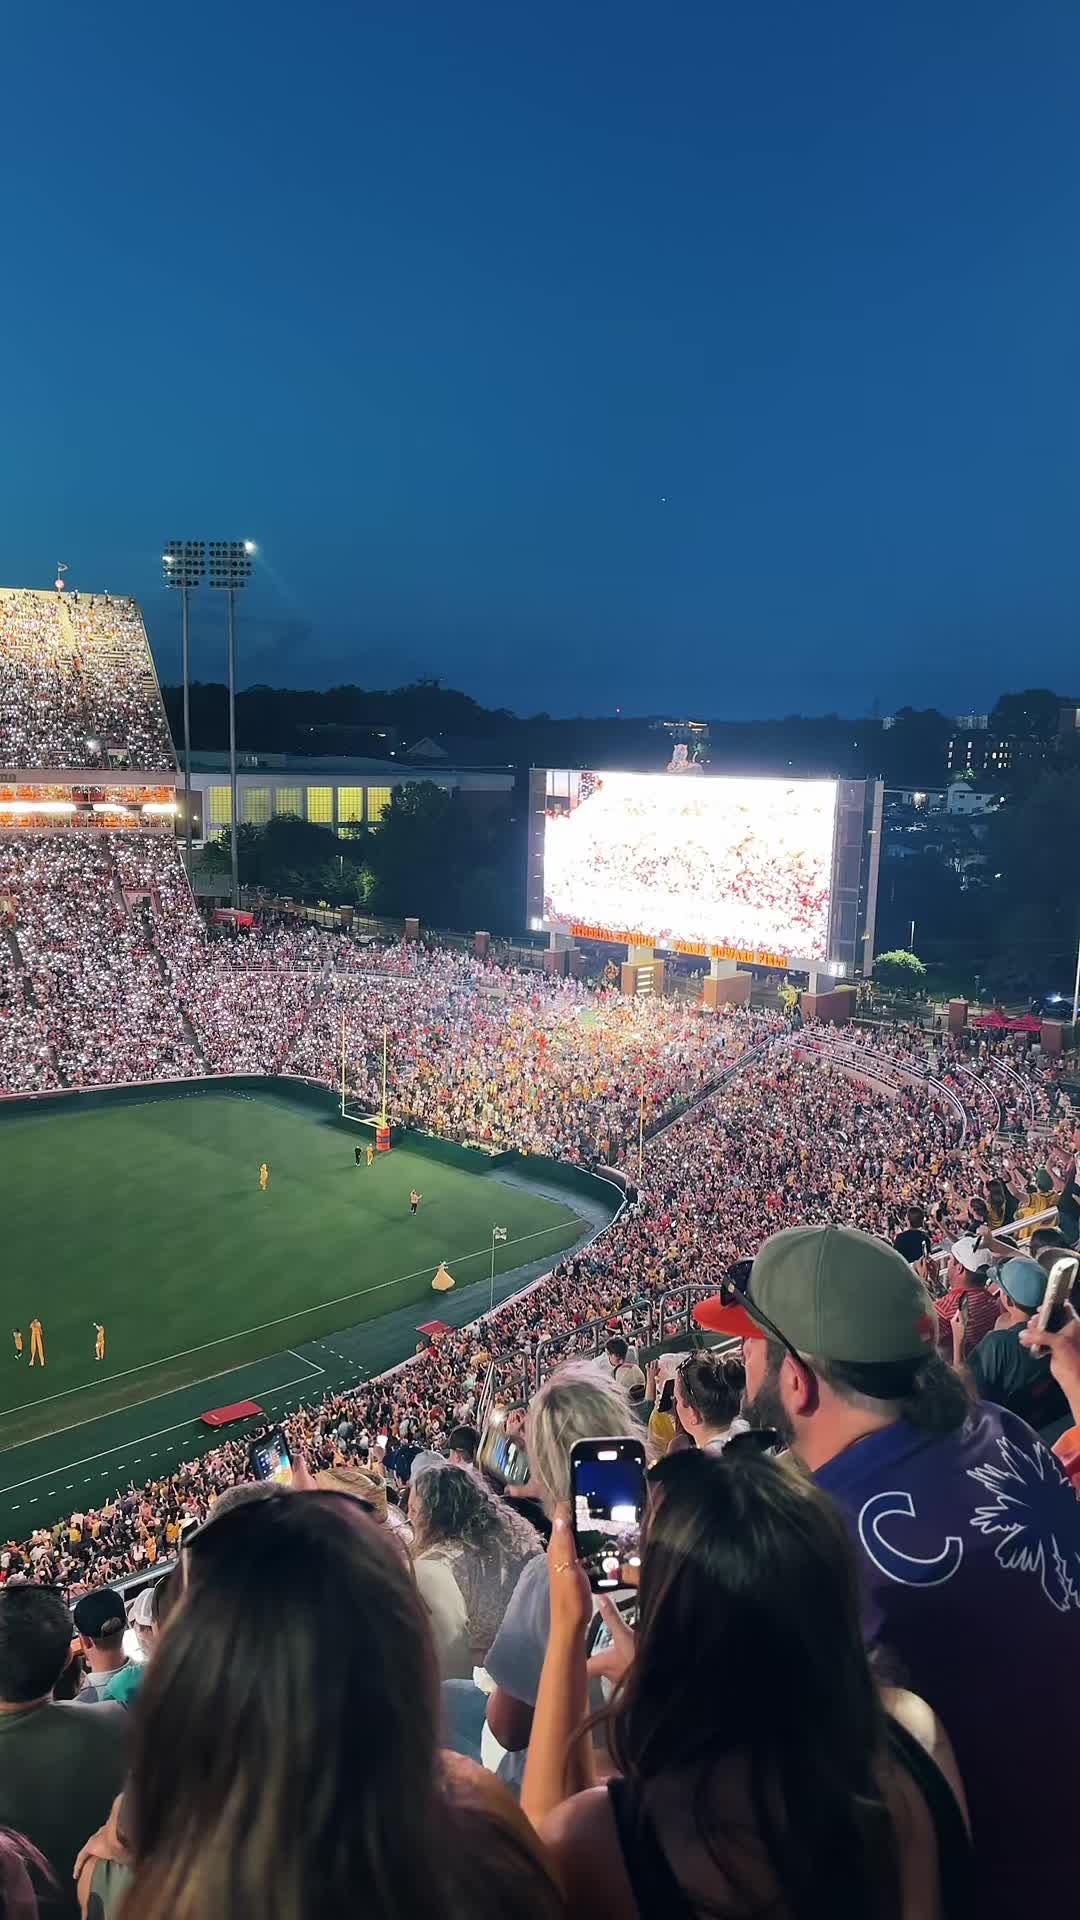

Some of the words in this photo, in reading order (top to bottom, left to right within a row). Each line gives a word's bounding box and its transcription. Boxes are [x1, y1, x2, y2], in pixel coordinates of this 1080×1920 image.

[570, 924, 612, 941] MEMORIAL
[614, 931, 656, 947] STADIUM
[674, 940, 706, 956] FRANK
[711, 945, 754, 962] HOWARD
[758, 951, 788, 968] FIELD
